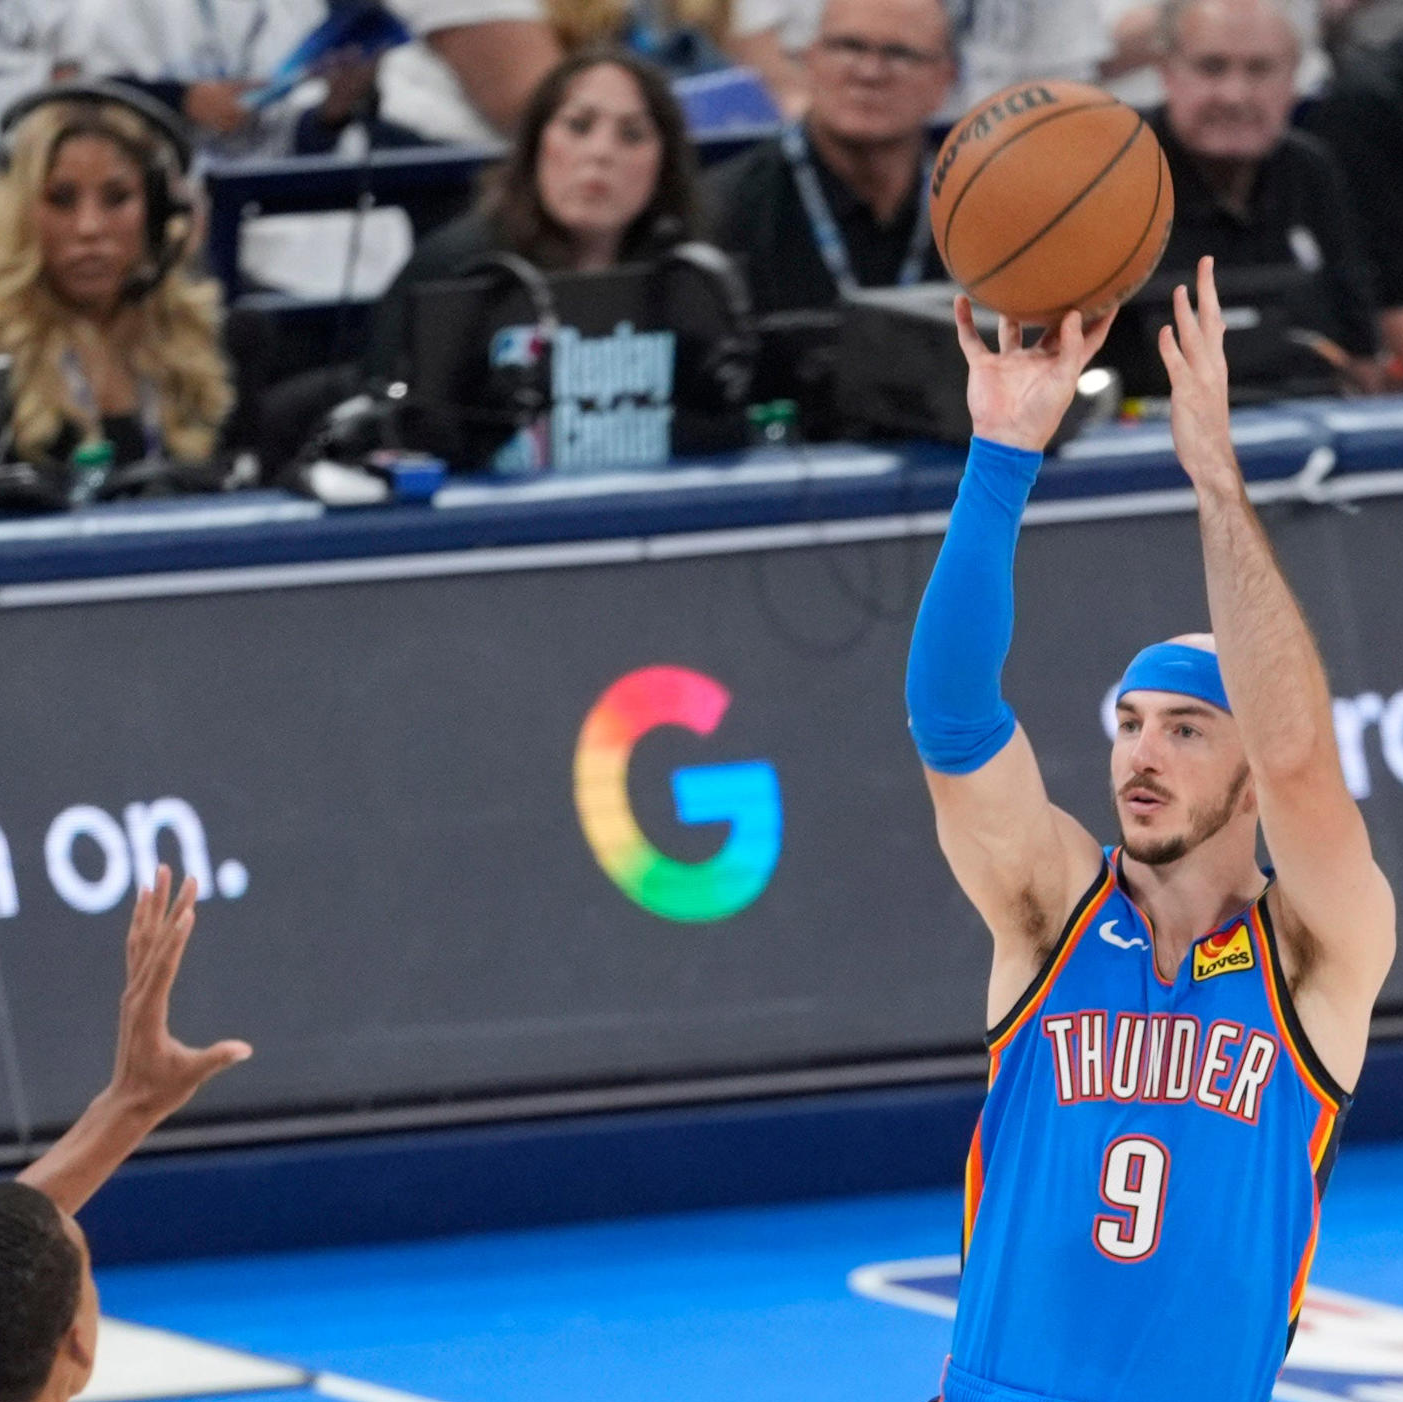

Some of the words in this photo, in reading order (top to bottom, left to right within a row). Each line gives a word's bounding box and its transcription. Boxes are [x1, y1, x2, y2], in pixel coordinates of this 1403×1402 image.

[44, 796, 250, 915] on.
[574, 664, 785, 924] G
[1041, 1009, 1280, 1126] THUNDER
[1092, 1133, 1171, 1264] 9
